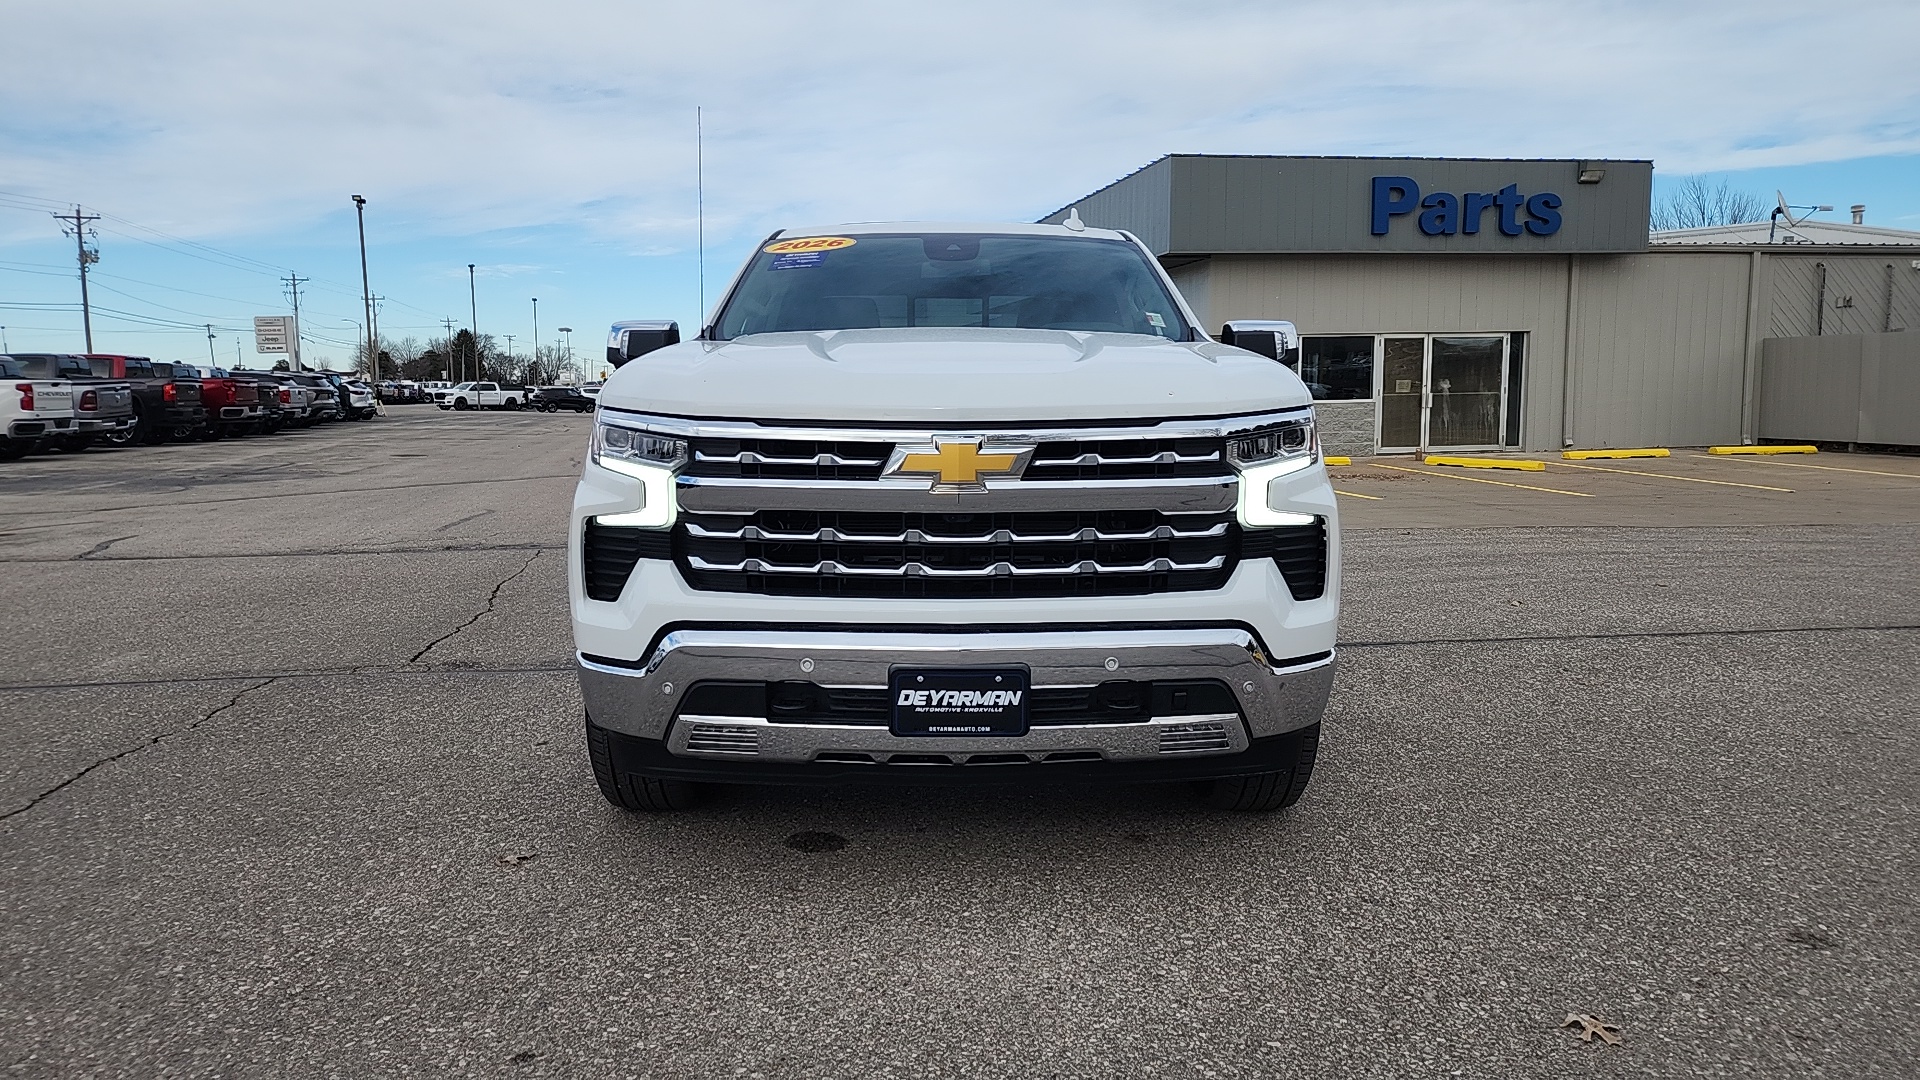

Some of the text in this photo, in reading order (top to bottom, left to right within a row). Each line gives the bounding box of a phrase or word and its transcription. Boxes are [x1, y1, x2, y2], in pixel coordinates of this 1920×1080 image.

[1371, 176, 1562, 235] Parts
[773, 239, 846, 252] 2026
[261, 335, 280, 343] Jeep
[897, 689, 1022, 706] DEYARMAN
